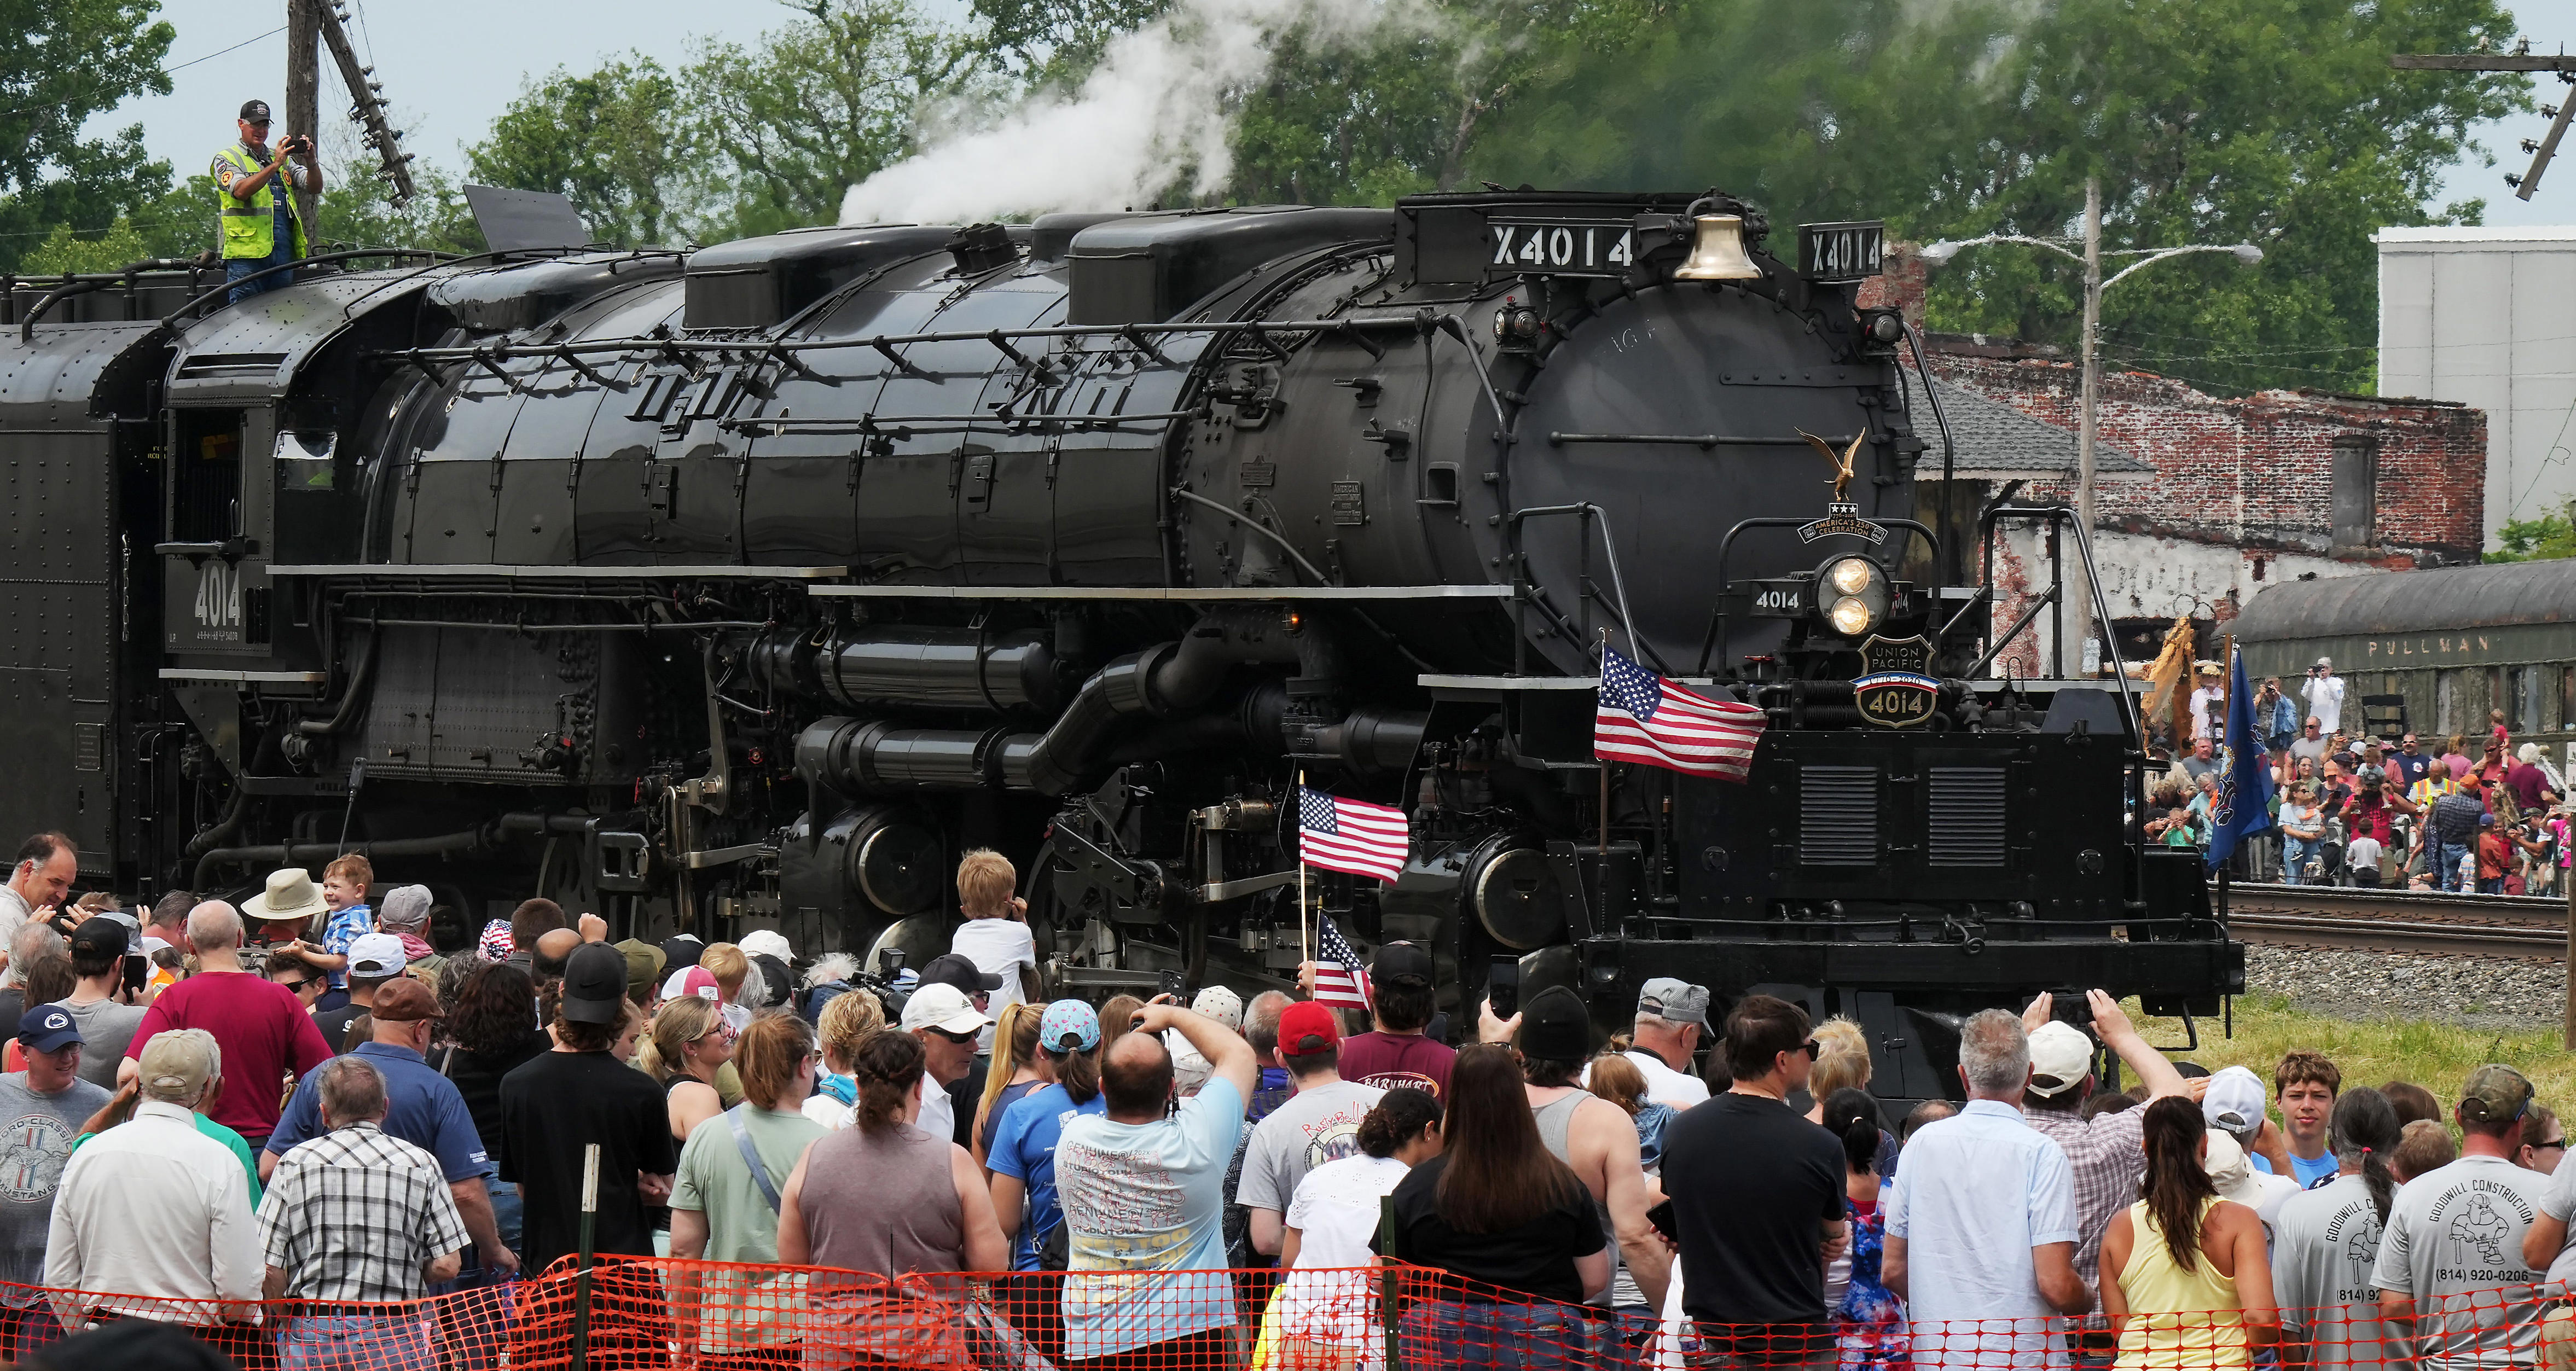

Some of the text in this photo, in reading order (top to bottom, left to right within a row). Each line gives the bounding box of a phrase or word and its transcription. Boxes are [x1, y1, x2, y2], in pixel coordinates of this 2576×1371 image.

[1493, 225, 1633, 266] X4014
[1812, 231, 1881, 271] X4014
[1815, 520, 1854, 529] AMERICA'S
[1819, 526, 1869, 536] CELEBRATION
[195, 565, 241, 627] 4014
[1756, 590, 1798, 608] 4014
[1876, 647, 1919, 657] UNION
[2369, 635, 2488, 657] PULLMAN
[1872, 659, 1922, 669] PACIFIC
[1869, 673, 1921, 684] 1776-2026
[1869, 690, 1923, 713] 4014
[1364, 1077, 1432, 1092] BARNHART
[0, 1121, 25, 1140] ORD
[2429, 1180, 2534, 1225] GOODWILL CONSTRUCTION
[2326, 1201, 2363, 1242] GOODWILL
[2435, 1269, 2528, 1282] (814) 920-0206
[2337, 1289, 2364, 1304] (814)
